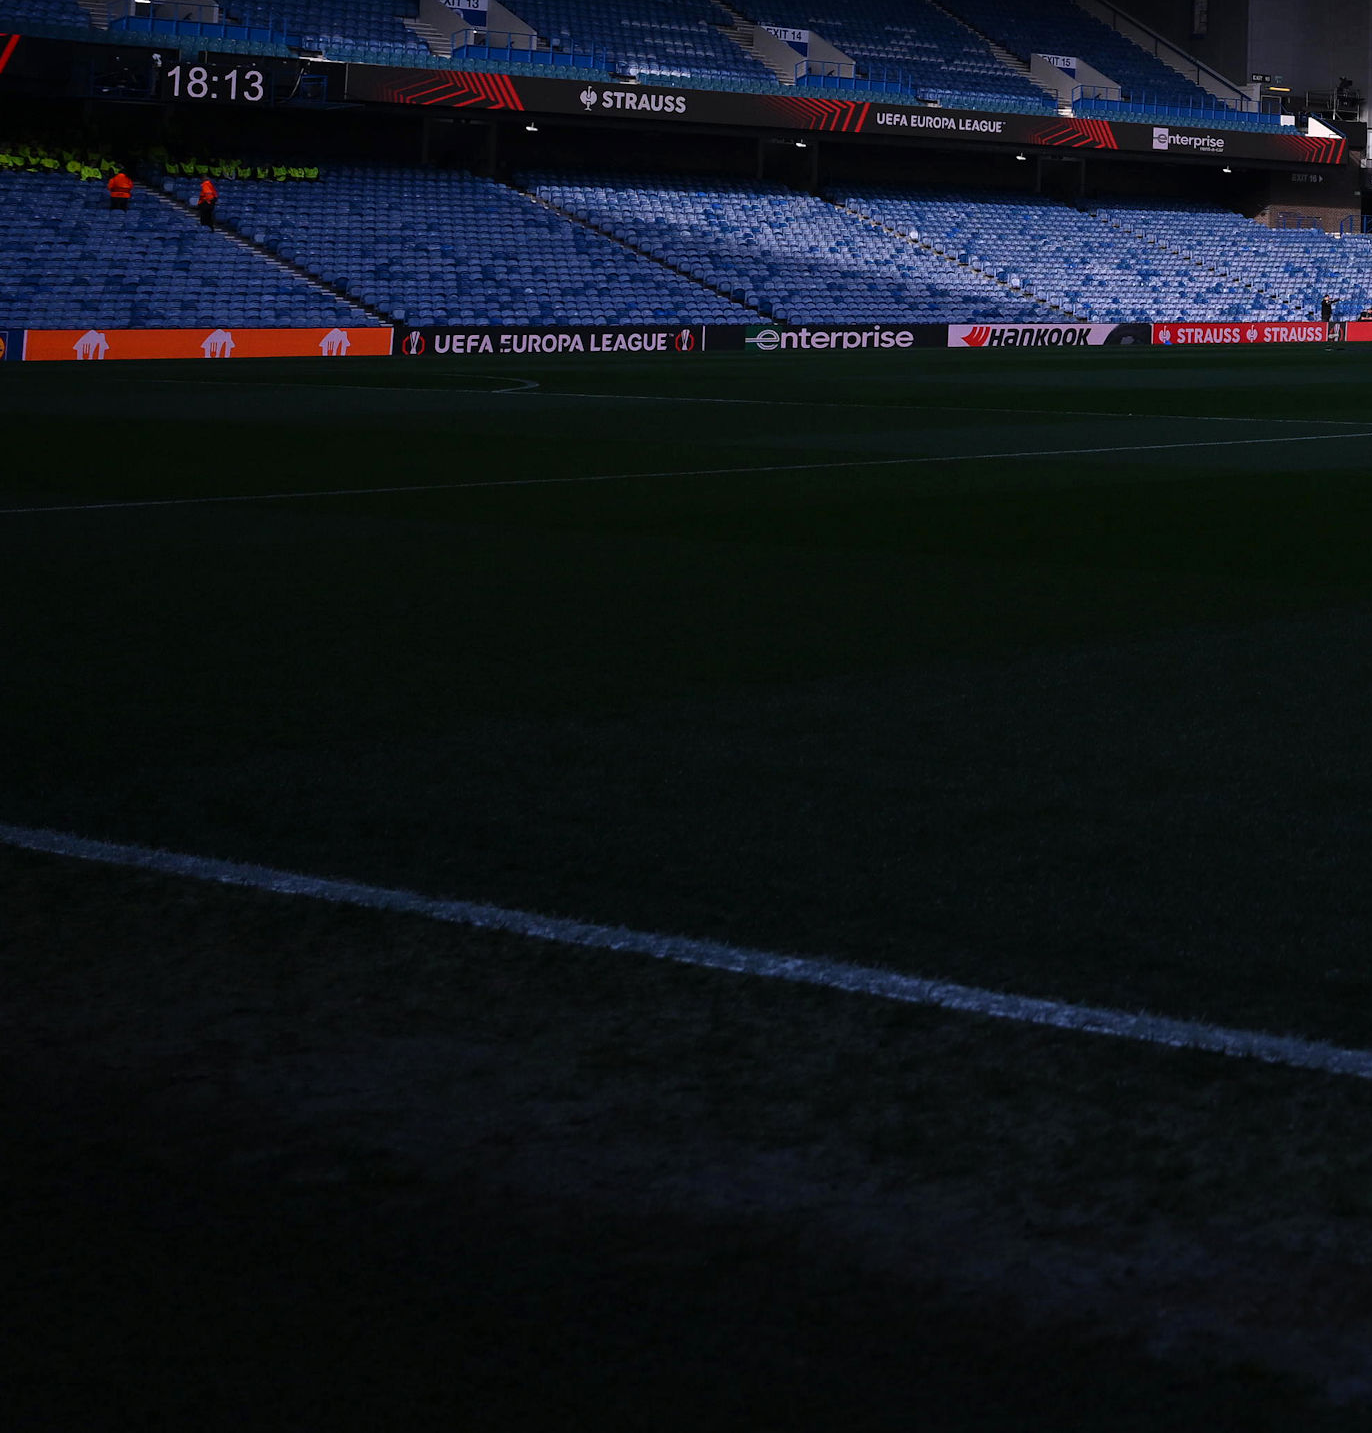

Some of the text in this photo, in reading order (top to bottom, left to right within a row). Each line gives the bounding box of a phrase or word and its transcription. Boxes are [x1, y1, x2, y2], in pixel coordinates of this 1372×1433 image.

[791, 28, 802, 40] 14
[1062, 56, 1071, 66] 15
[167, 66, 265, 102] 18:13
[602, 91, 687, 114] STRAUSS
[876, 113, 1002, 133] UEFA EUROPA LEAGUE
[1154, 131, 1225, 151] enterprise
[434, 332, 668, 354] UEFA EUROPA LEAGUE
[745, 325, 914, 351] enterprise
[1177, 326, 1322, 344] STRAUSS STRAUSS
